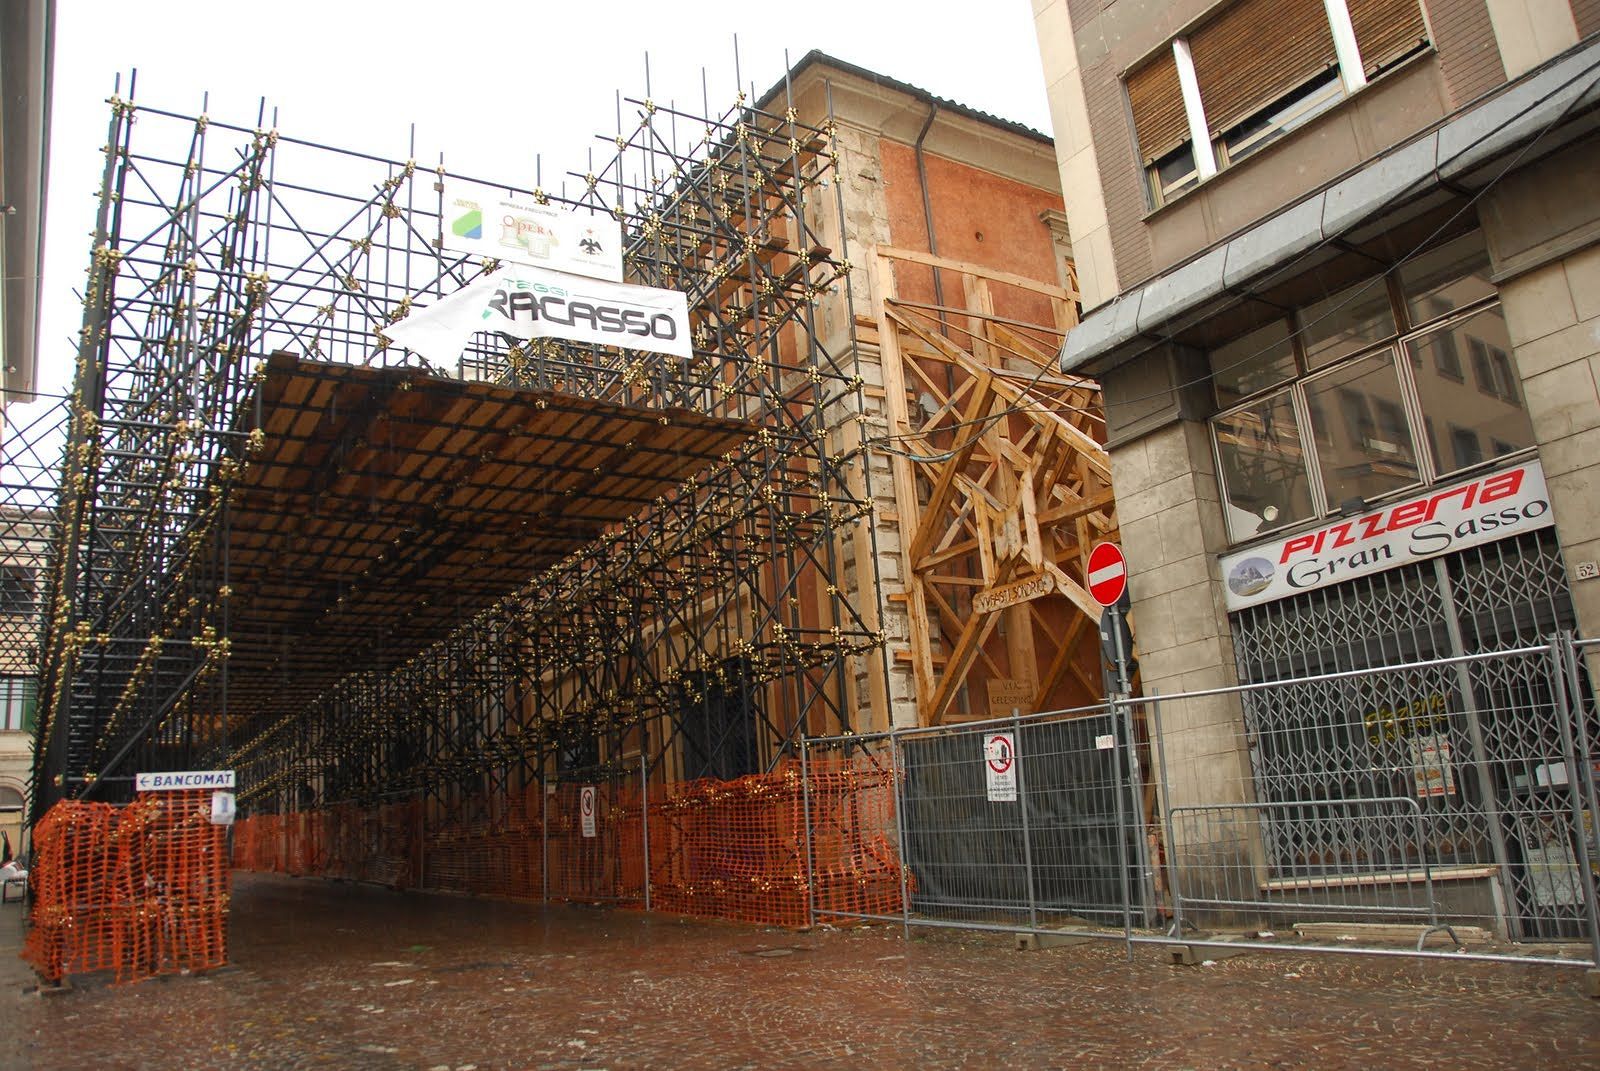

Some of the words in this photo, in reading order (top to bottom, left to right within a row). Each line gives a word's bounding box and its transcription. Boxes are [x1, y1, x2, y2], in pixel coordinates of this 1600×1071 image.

[1286, 544, 1392, 588] Gran
[1408, 499, 1548, 556] Sasso
[1578, 563, 1593, 577] 52
[153, 773, 232, 787] BANCOMAT
